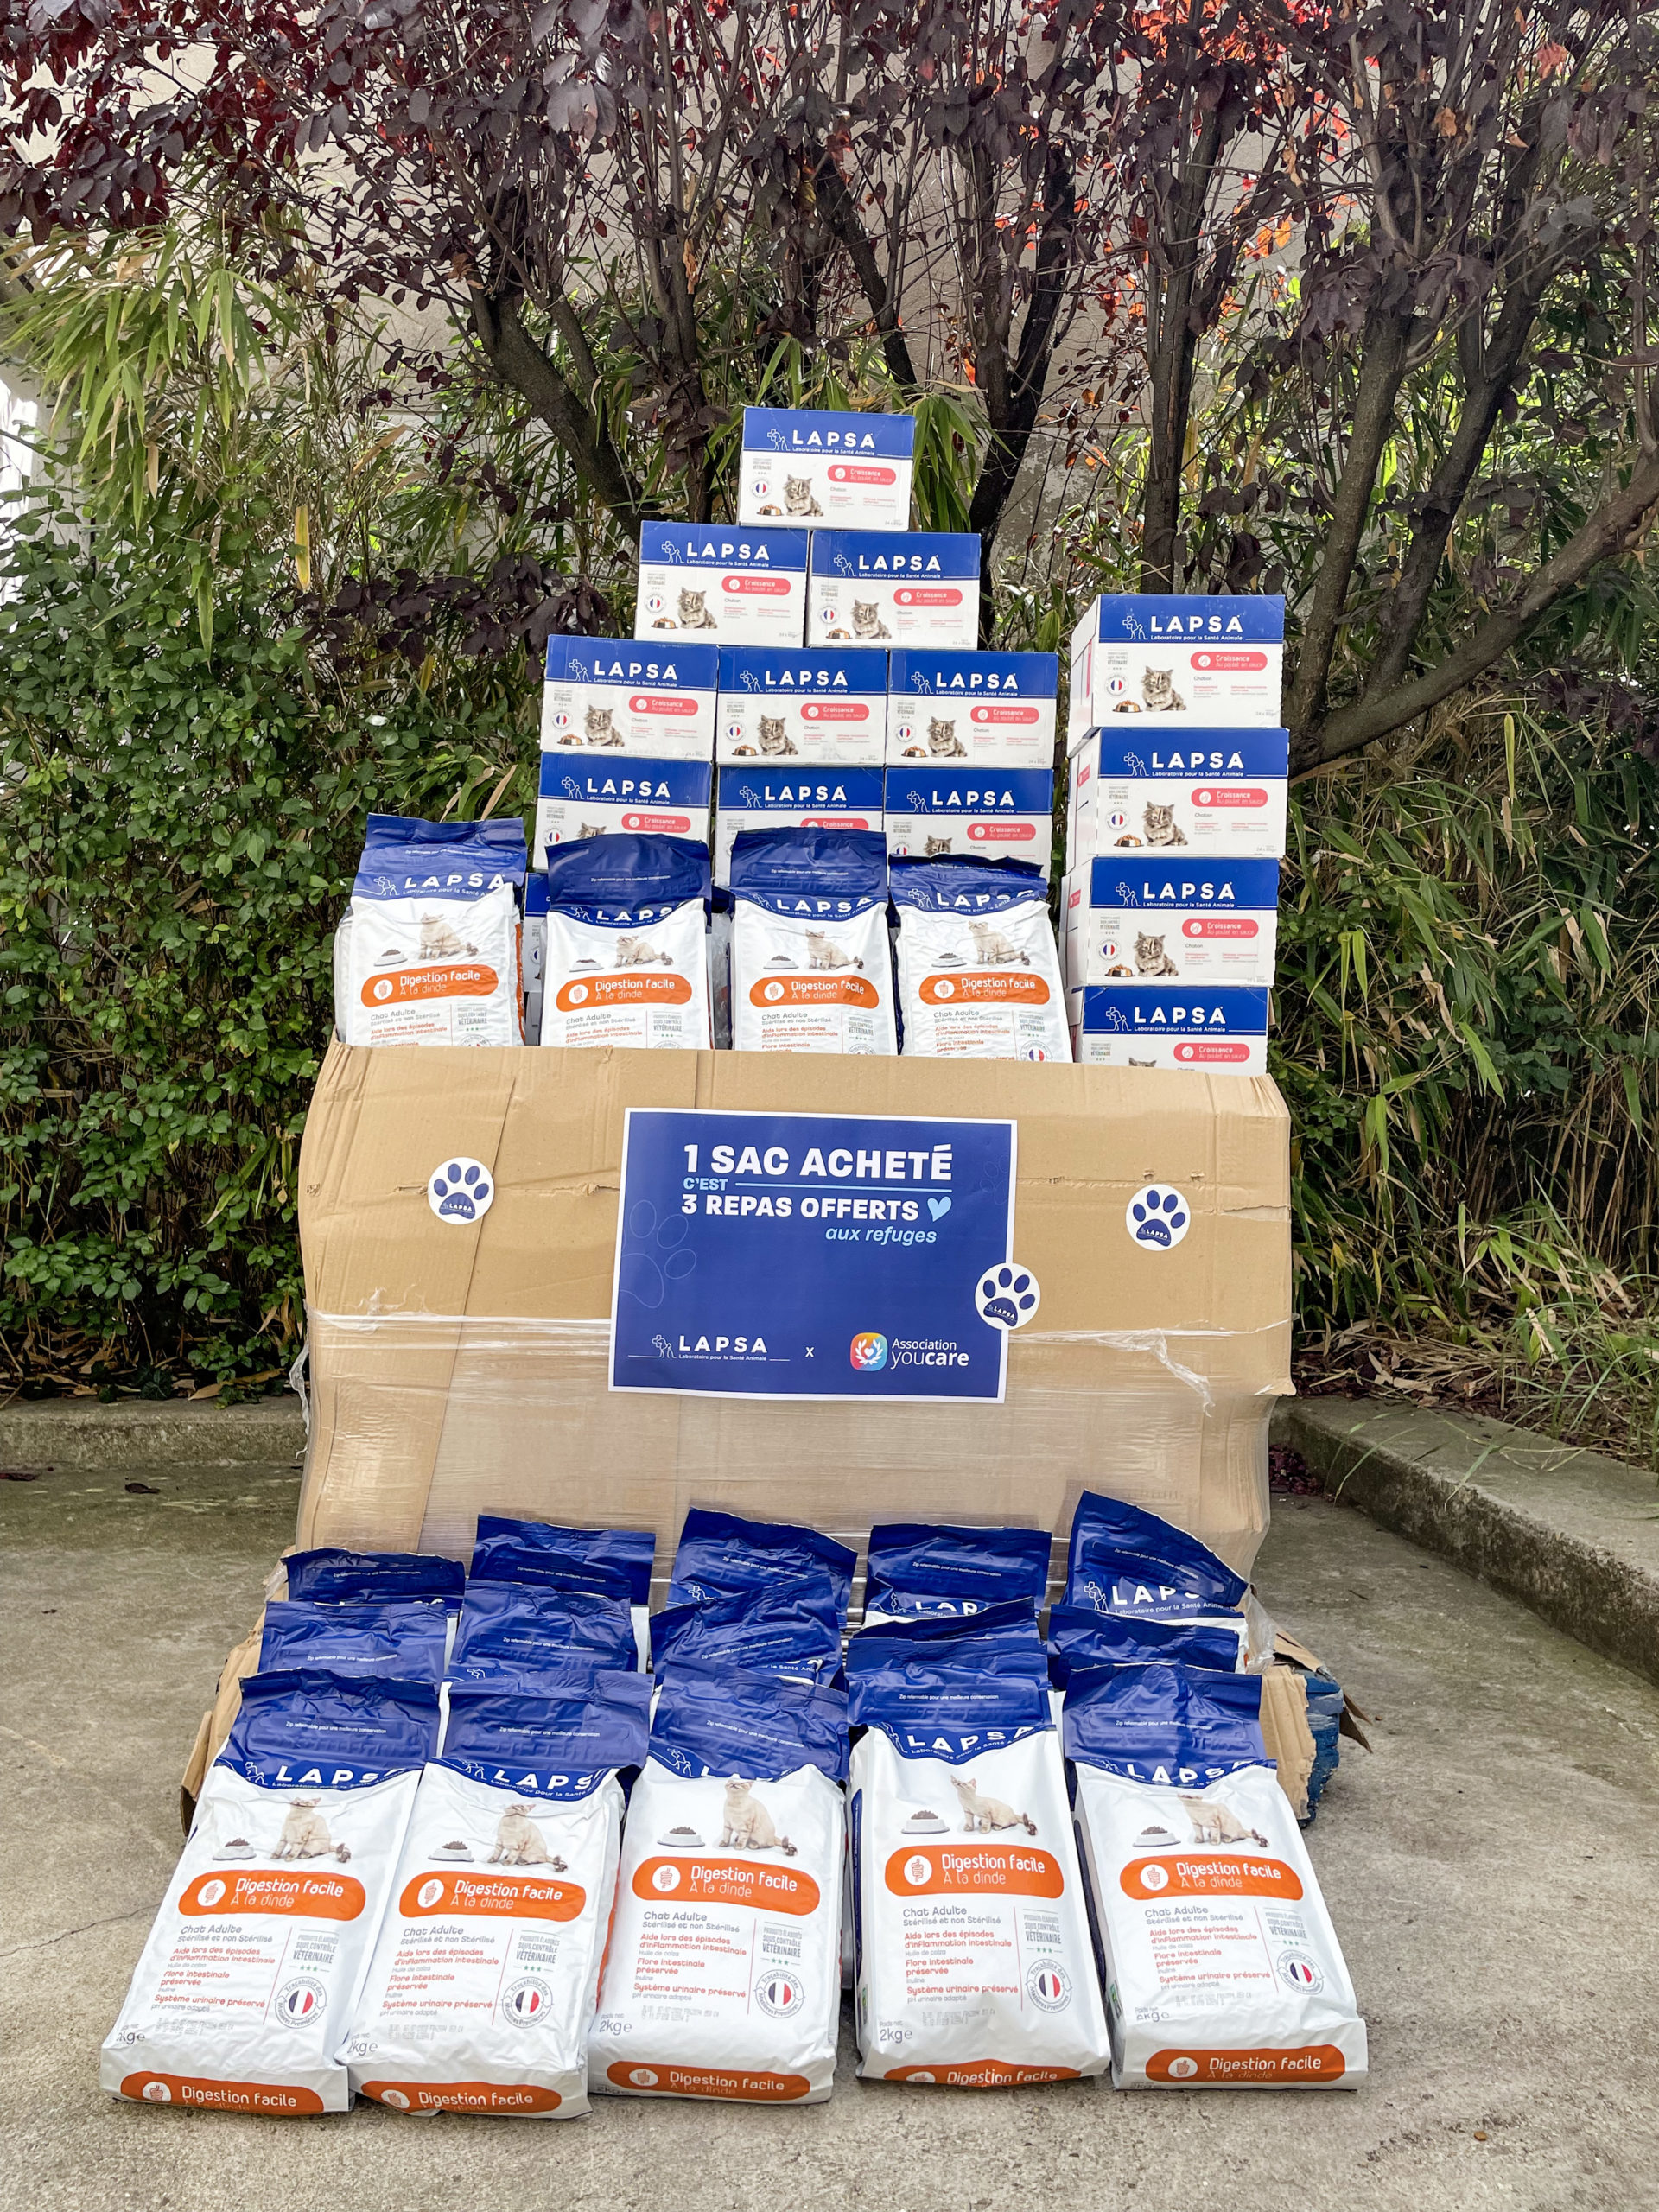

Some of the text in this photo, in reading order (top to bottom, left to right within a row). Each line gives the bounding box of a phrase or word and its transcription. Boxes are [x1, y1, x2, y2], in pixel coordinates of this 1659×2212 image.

[792, 430, 874, 448] LAPSA
[687, 542, 769, 560] LAPSA
[859, 555, 941, 571] LAPSA
[1151, 616, 1243, 632] LAPSA
[594, 661, 677, 680] LAPSA
[766, 671, 848, 686] LAPSA
[936, 672, 1018, 689] LAPSA
[1152, 752, 1243, 769] LAPSA
[587, 778, 671, 798] LAPSA
[765, 786, 847, 801] LAPSA
[932, 791, 1014, 806] LAPSA
[1144, 882, 1235, 899] LAPSA
[596, 905, 677, 921] LAPS
[400, 970, 480, 986] Digestion facile
[595, 978, 675, 991] Digestion facile
[962, 978, 1035, 989] Digestion facile
[791, 980, 864, 995] Digestion facile
[1134, 1007, 1225, 1024] LAPSA
[684, 1143, 952, 1180] 1 SAC ACHETÉ
[683, 1177, 728, 1191] C'EST
[682, 1193, 918, 1221] 3 REPAS OFFERTS
[825, 1226, 937, 1246] aux refuges
[679, 1335, 767, 1353] LAPSA
[892, 1338, 957, 1351] Association
[890, 1351, 969, 1370] youcare
[916, 1601, 978, 1615] LAP
[494, 1769, 603, 1789] LAPS
[942, 1854, 1045, 1873] Digestion facile
[1177, 1862, 1281, 1879] Digestion facile
[691, 1866, 798, 1892] Digestion facile
[957, 1873, 969, 1884] la
[973, 1873, 1006, 1885] dinde
[1193, 1877, 1205, 1887] la
[1210, 1877, 1243, 1888] dinde
[236, 1878, 344, 1897] Digestion facile
[454, 1880, 563, 1900] Digestion facile
[703, 1883, 715, 1893] la
[719, 1884, 753, 1897] dinde
[245, 1893, 257, 1906] la
[261, 1894, 295, 1908] dinde
[464, 1895, 476, 1905] la
[480, 1897, 513, 1910] dinde
[644, 1911, 707, 1922] Chat Adulte
[903, 1906, 967, 1917] Chat Adulte
[1145, 1905, 1208, 1918] Chat Adulte
[181, 1924, 242, 1934] Chat Adulte
[404, 1926, 463, 1936] Chat Adulte
[959, 1930, 994, 1939] épisodes
[906, 1967, 949, 1976] préservée
[907, 1986, 944, 1995] Système
[982, 1984, 1018, 1994] préservé
[1209, 2056, 1321, 2071] Digestion facile
[670, 2071, 785, 2091] Digestion facile
[947, 2069, 1058, 2085] Digestion facile
[182, 2086, 296, 2107] Digestion facile
[419, 2092, 533, 2107] Digestion facile
